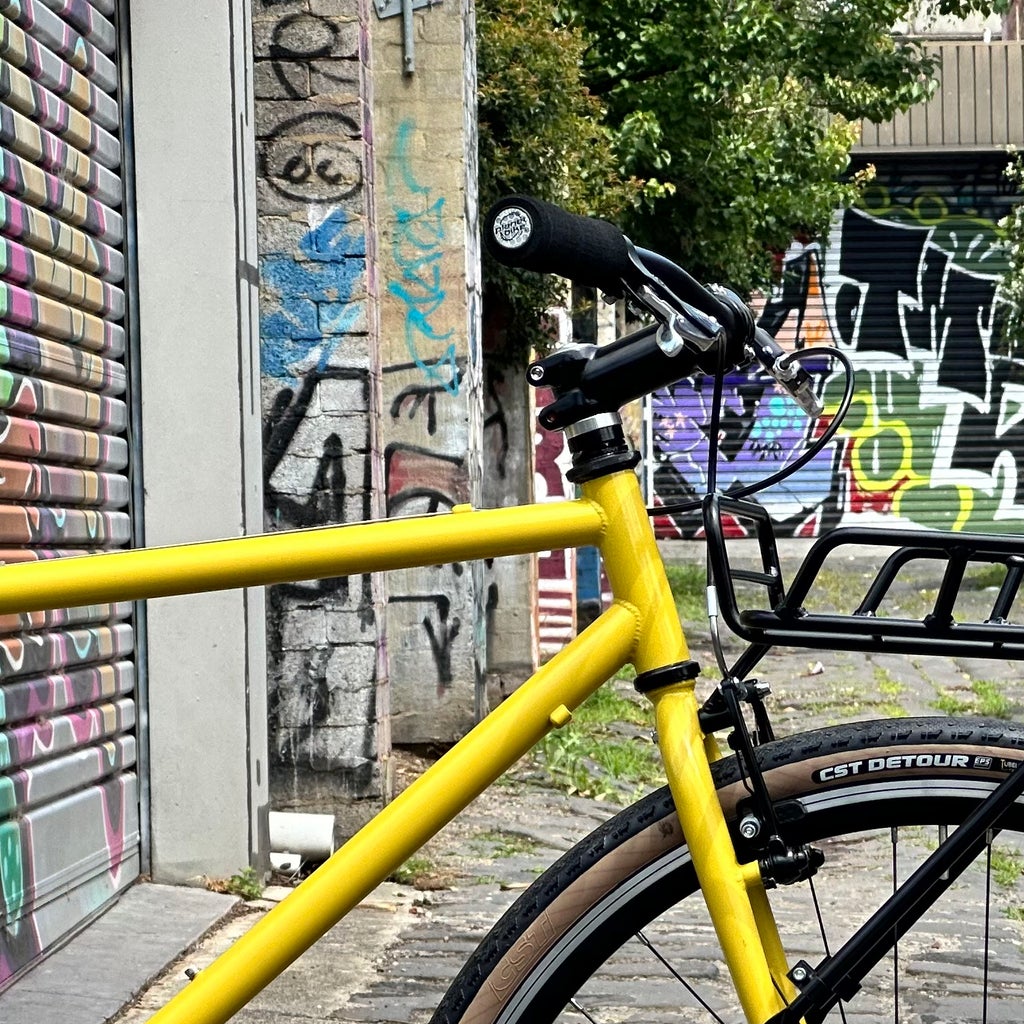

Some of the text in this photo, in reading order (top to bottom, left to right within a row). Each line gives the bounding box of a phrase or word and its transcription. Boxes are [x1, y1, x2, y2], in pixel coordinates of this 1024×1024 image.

[820, 754, 968, 782] CST DETOUR
[492, 912, 556, 994] CST
